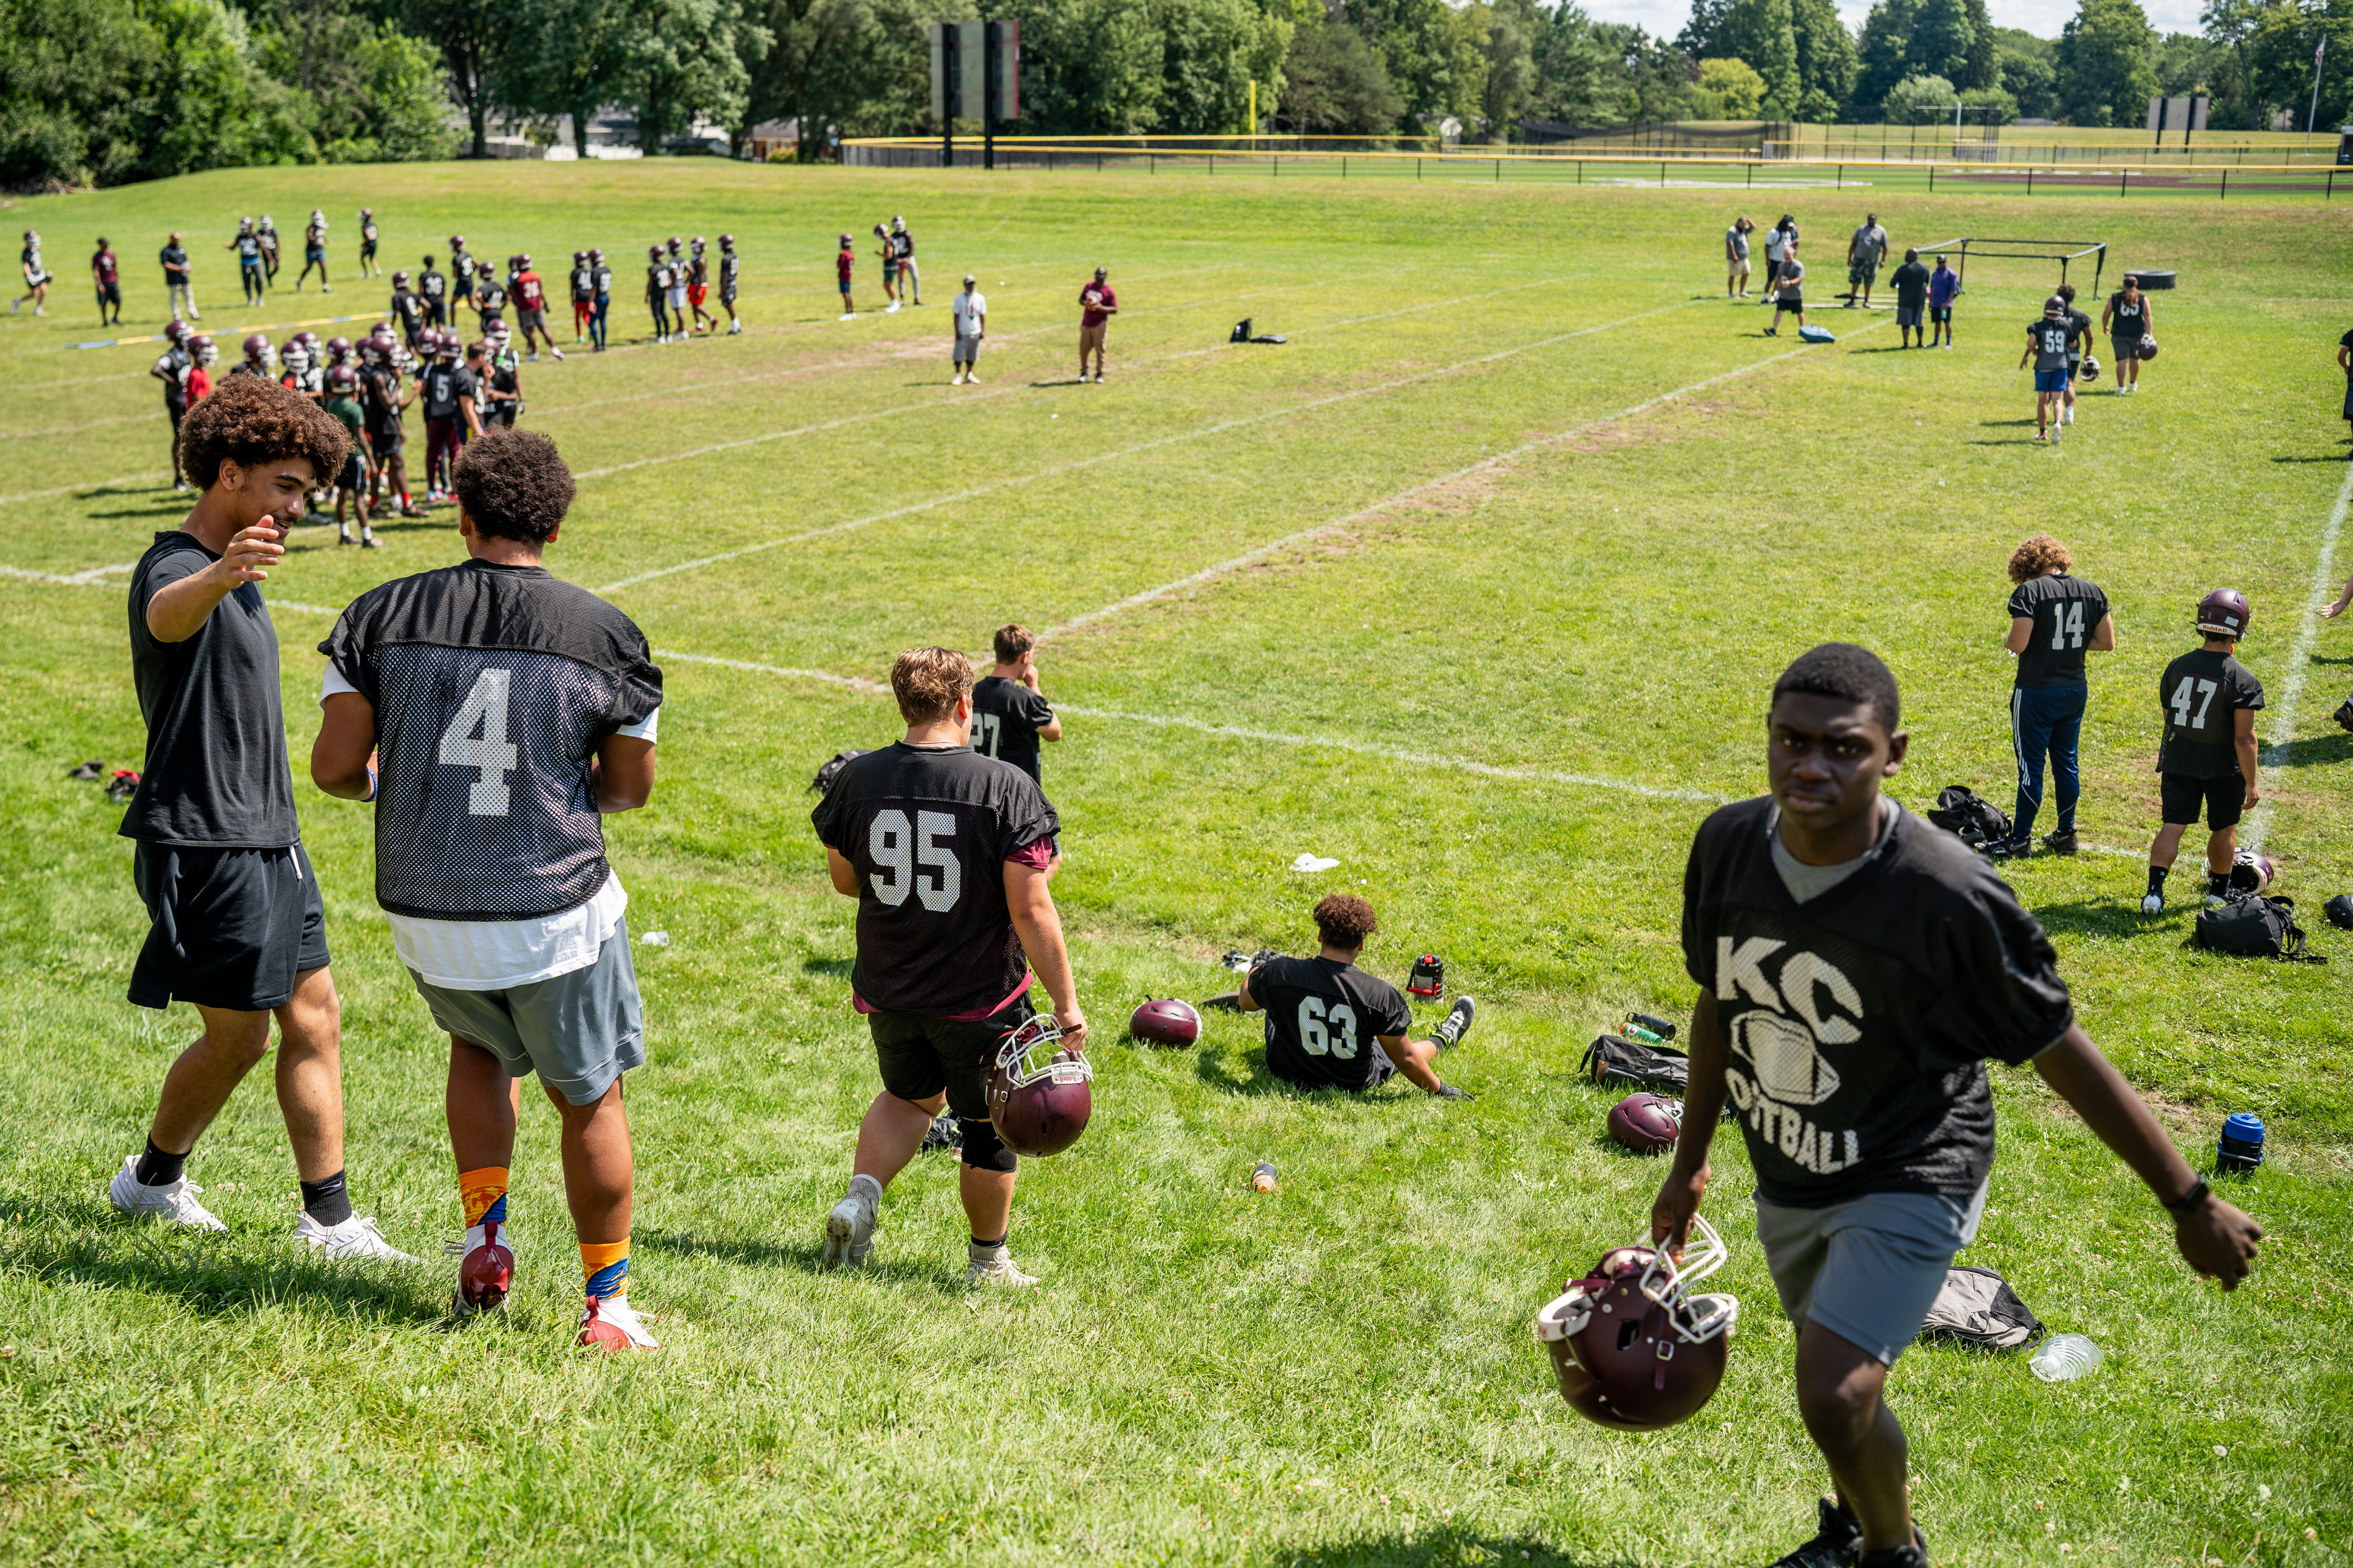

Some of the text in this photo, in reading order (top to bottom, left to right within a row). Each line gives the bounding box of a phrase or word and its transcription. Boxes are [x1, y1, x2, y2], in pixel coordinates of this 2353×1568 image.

[2045, 330, 2065, 354] 59
[436, 374, 449, 402] 5
[2052, 601, 2085, 650] 14
[2202, 624, 2228, 634] Riddell
[2171, 675, 2218, 730] 47
[439, 668, 518, 817] 4
[869, 809, 961, 912] 95
[1716, 935, 1864, 1045] KC
[1298, 995, 1358, 1060] 63
